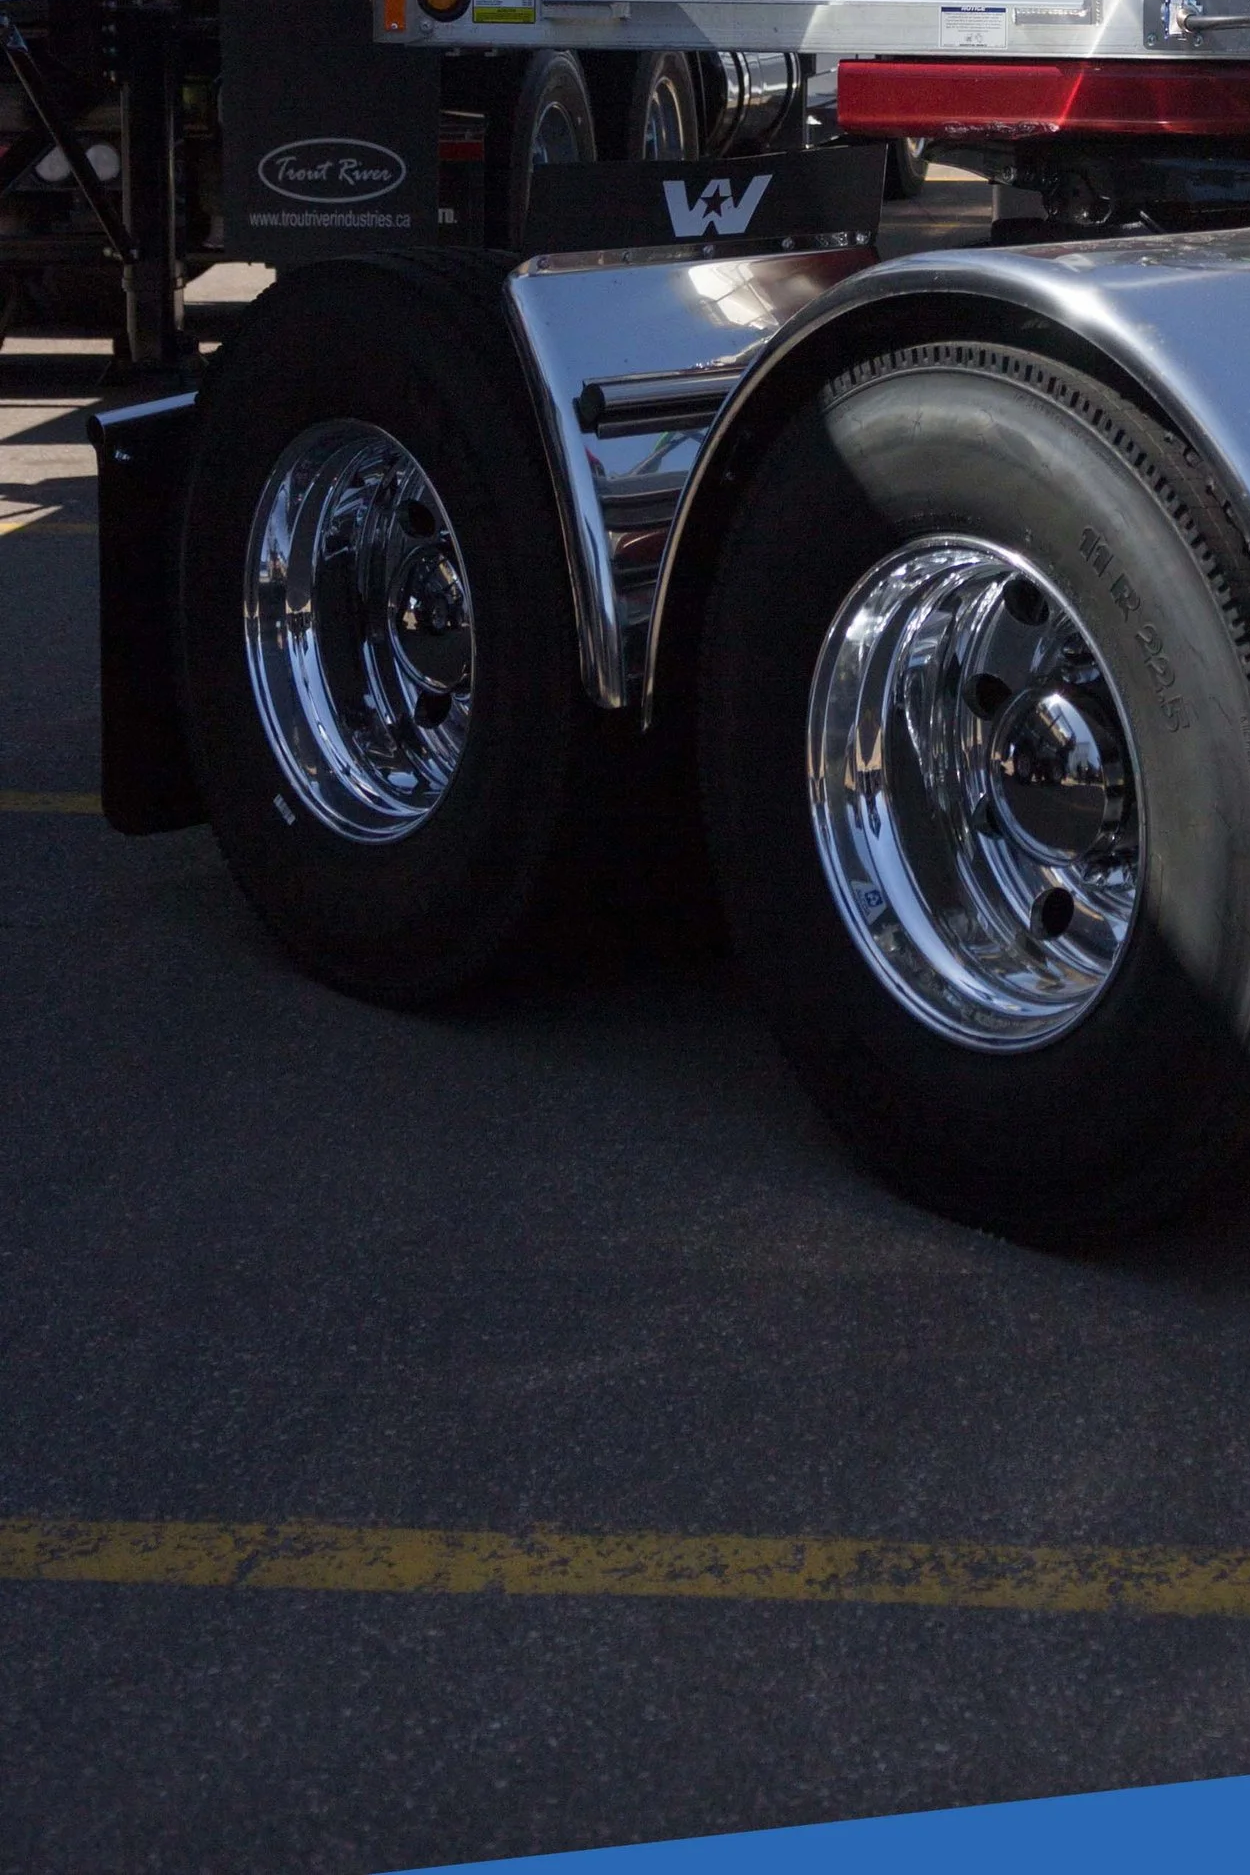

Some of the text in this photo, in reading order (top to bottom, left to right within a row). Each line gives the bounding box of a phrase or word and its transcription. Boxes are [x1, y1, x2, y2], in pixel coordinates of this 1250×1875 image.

[276, 156, 393, 185] Trout River
[250, 209, 411, 227] www.troutriverindustries.ca
